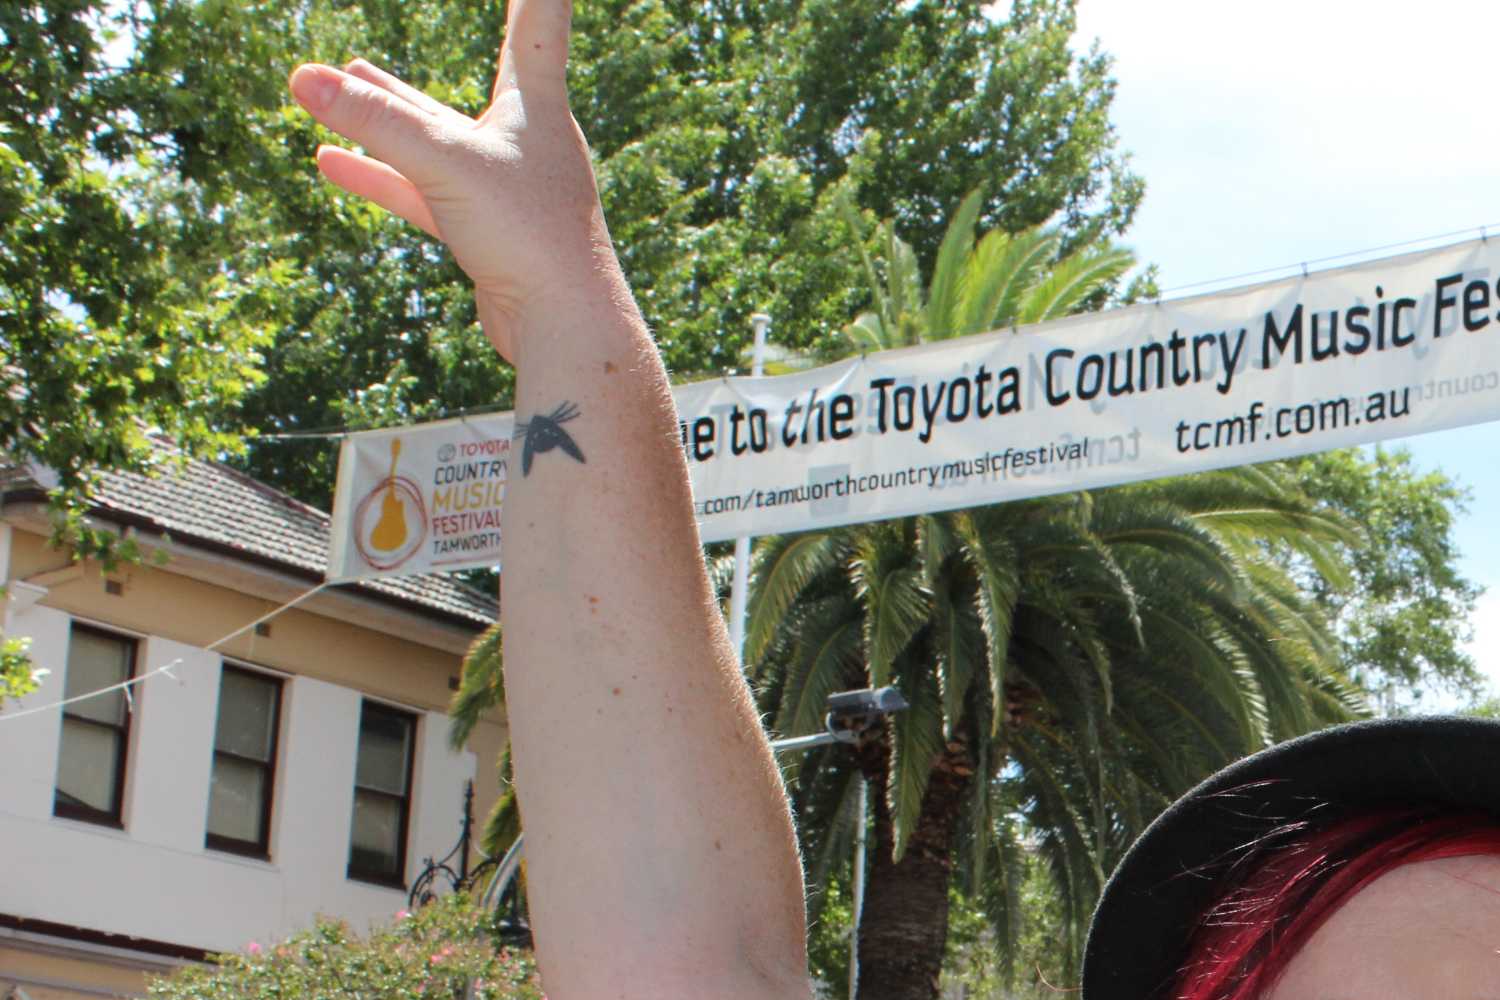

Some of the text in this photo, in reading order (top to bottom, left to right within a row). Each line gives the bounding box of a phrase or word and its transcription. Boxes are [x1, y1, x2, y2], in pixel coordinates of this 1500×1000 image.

[729, 404, 768, 456] to
[782, 388, 855, 447] the
[870, 363, 1021, 443] Toyota
[1044, 327, 1247, 407] Country
[1261, 286, 1417, 370] Music
[1174, 385, 1412, 454] tcmf.com.au
[460, 438, 510, 457] TOYOTA
[431, 481, 505, 515] MUSIC
[432, 510, 501, 536] FESTIVAL
